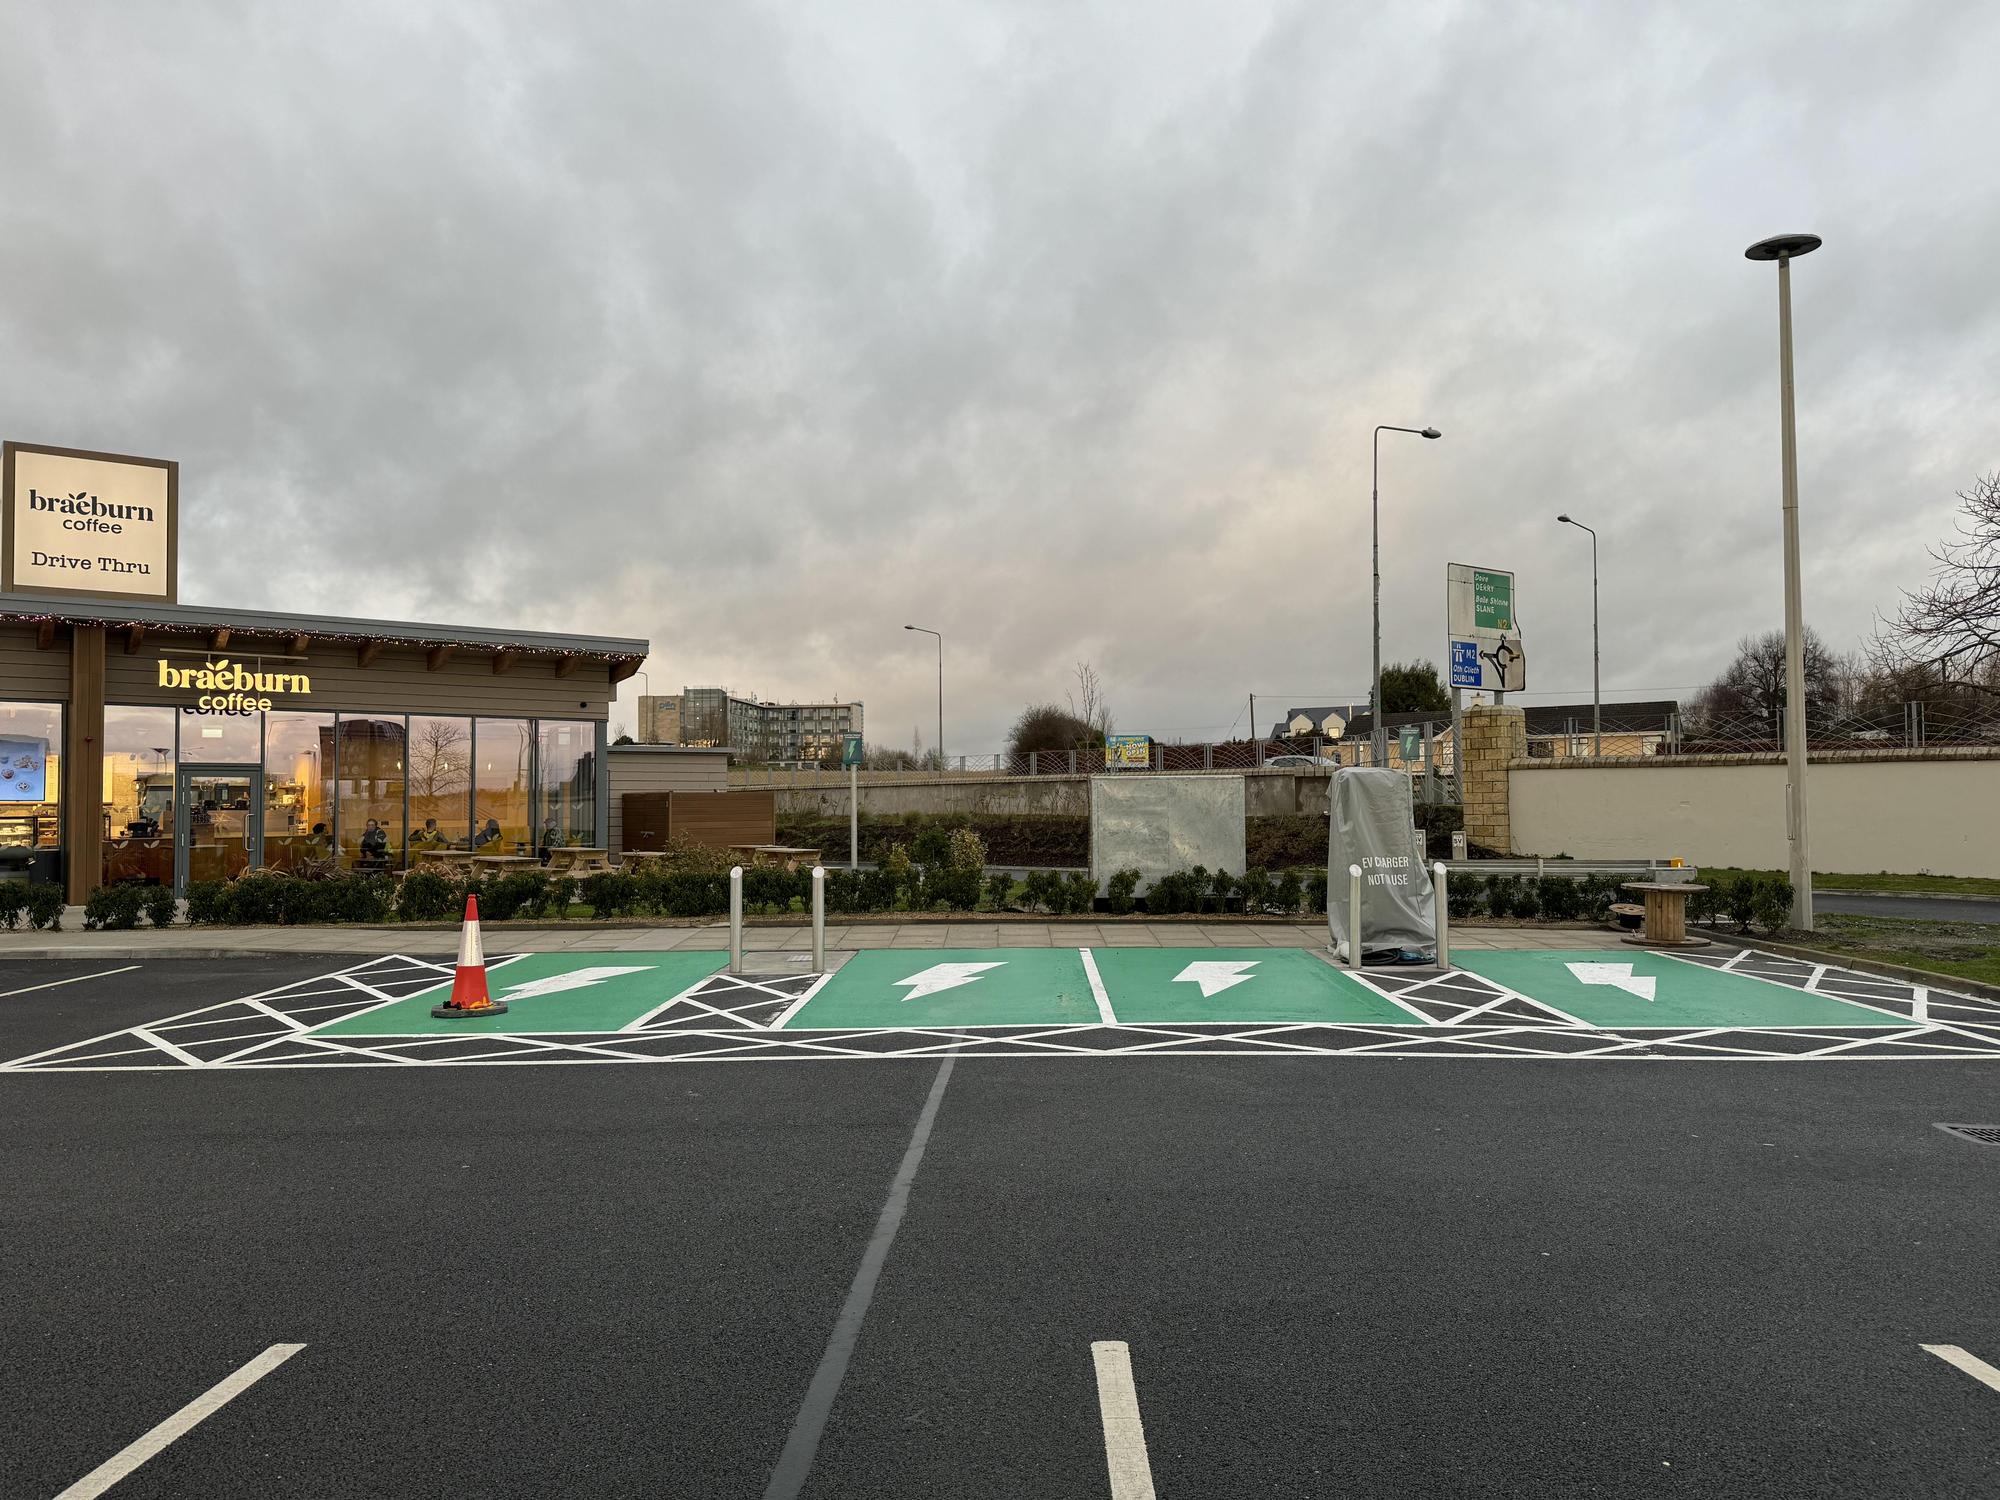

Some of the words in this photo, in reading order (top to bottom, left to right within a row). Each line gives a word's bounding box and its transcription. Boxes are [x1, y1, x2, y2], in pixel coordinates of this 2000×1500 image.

[29, 489, 154, 522] braeburn
[63, 518, 122, 534] coffee
[31, 551, 92, 570] Drive
[98, 557, 151, 575] Thru
[1475, 583, 1494, 592] DERRY
[1476, 605, 1495, 614] SLANE
[1497, 618, 1508, 628] N2
[1466, 649, 1476, 660] M2
[158, 659, 311, 694] braeburn
[1453, 674, 1475, 683] DUBLIN
[198, 693, 272, 711] coffee
[1126, 748, 1145, 756] OPEN
[1362, 857, 1373, 868] EV
[1367, 873, 1384, 886] NOT
[1391, 874, 1408, 885] USE
